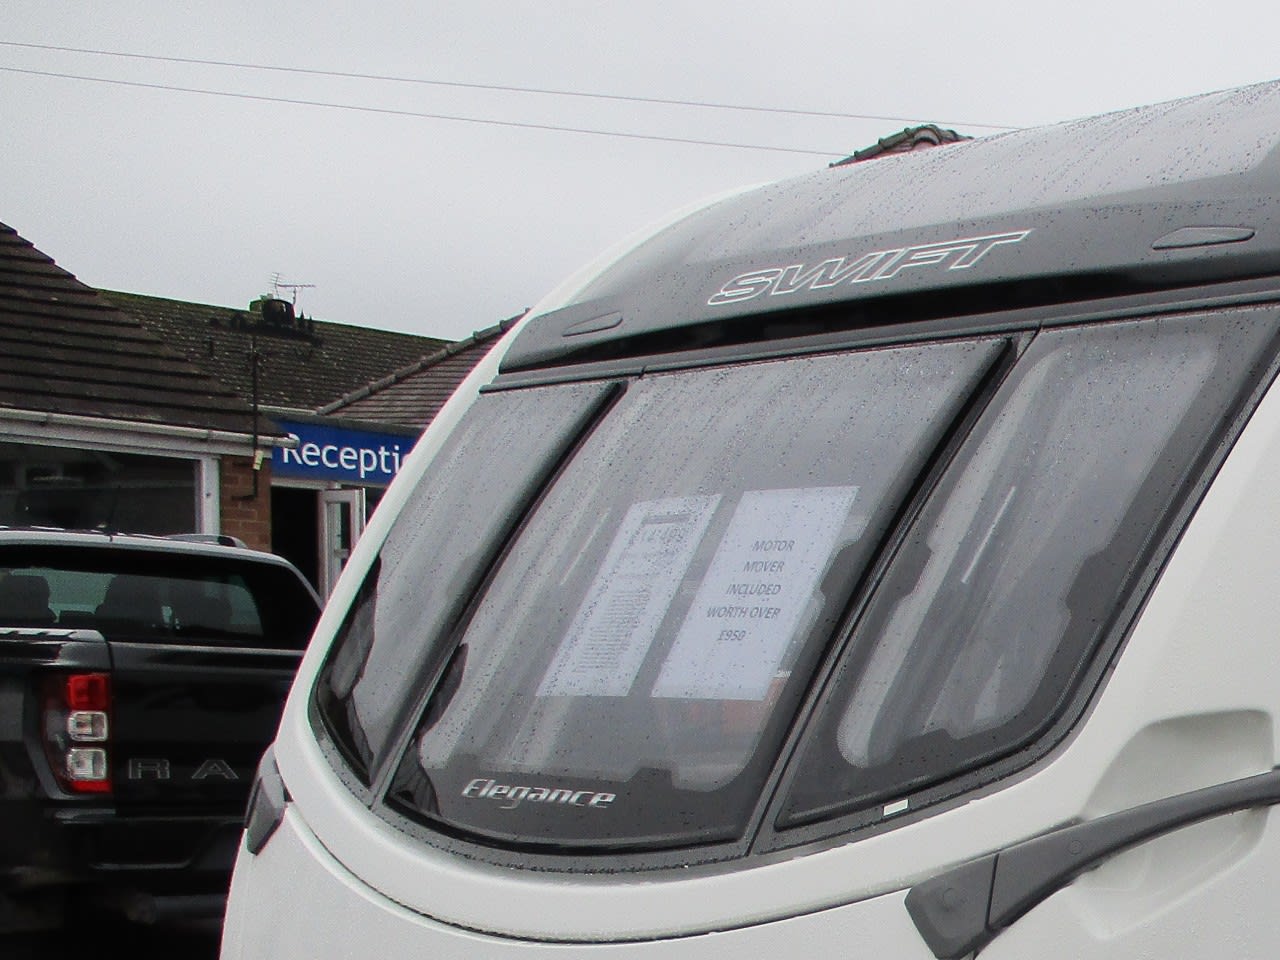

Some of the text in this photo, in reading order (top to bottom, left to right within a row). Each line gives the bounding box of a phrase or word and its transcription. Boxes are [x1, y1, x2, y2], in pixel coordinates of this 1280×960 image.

[707, 228, 1034, 306] SWIFT
[282, 442, 408, 479] Recepti
[752, 539, 795, 552] MOTOR
[743, 560, 785, 573] MOVER
[726, 583, 782, 596] INCLUDED
[706, 606, 782, 619] WORTH OVER
[716, 629, 746, 642] £950
[461, 777, 617, 810] Elegance
